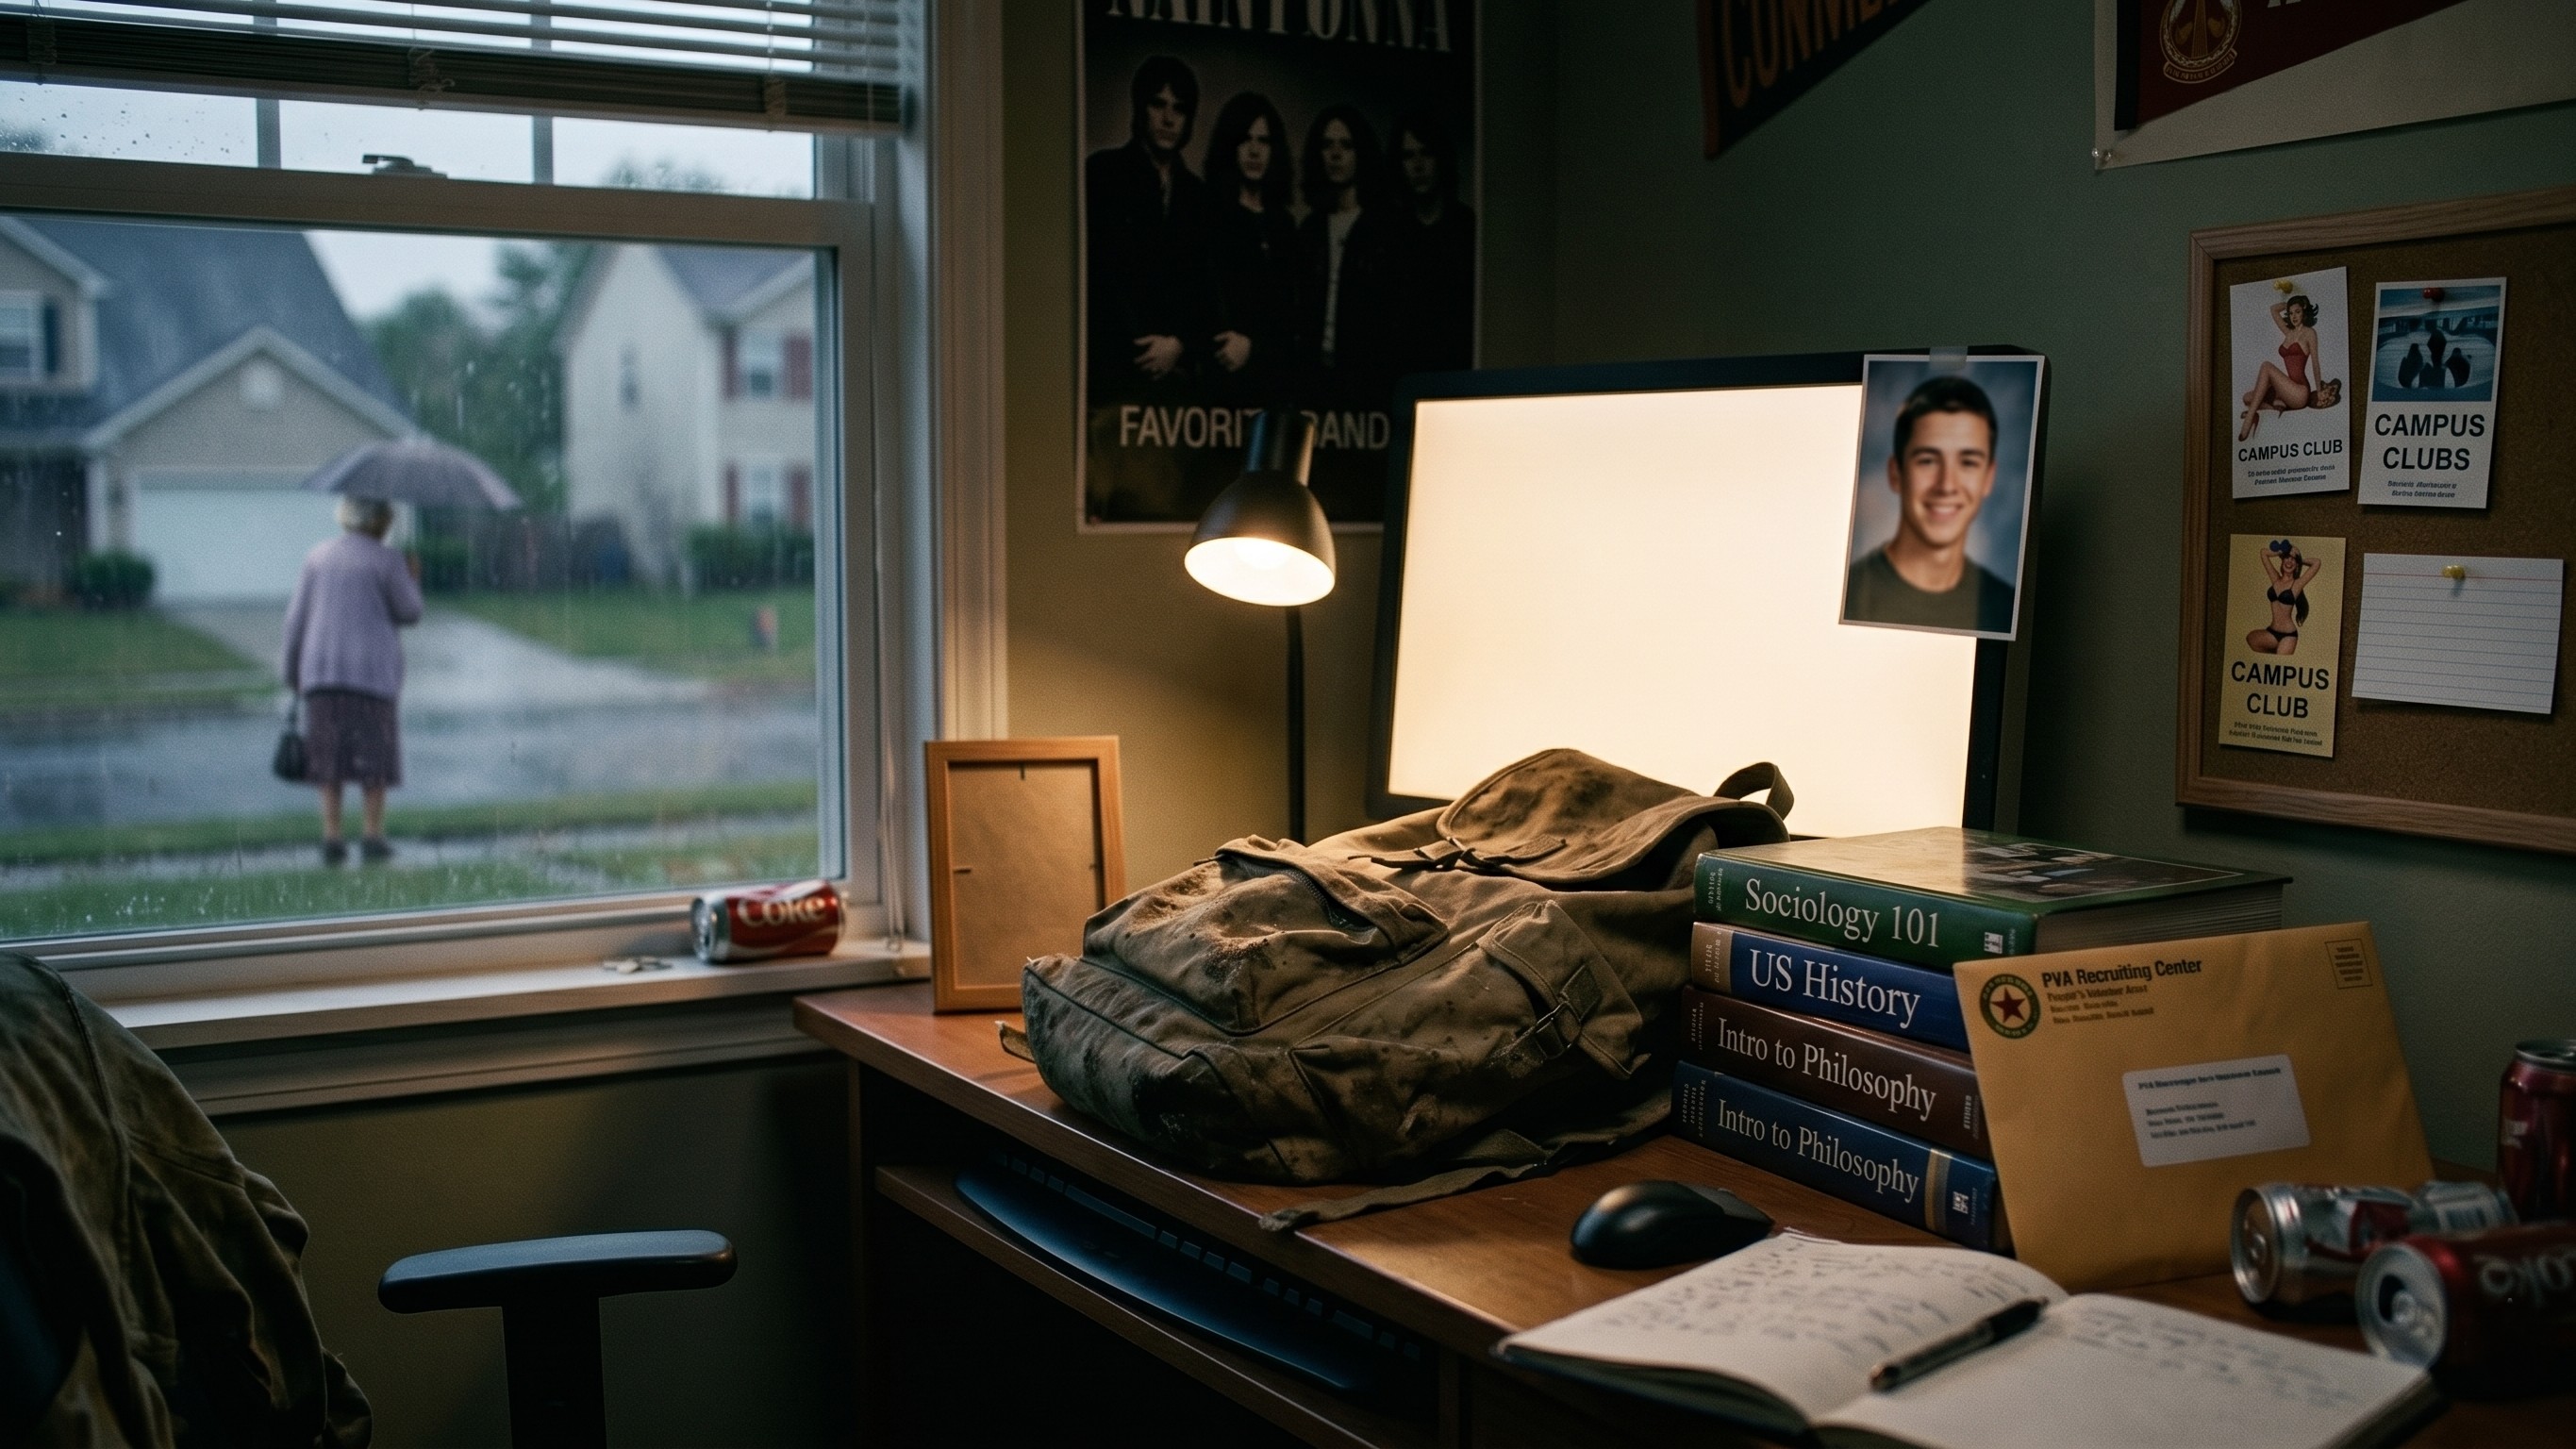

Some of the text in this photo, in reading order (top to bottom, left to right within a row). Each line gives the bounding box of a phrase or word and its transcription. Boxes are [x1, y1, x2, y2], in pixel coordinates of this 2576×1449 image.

[1119, 404, 1264, 449] FAVORI
[2375, 413, 2485, 437] CAMPUS
[2238, 439, 2343, 462] CAMPUS CLUB
[2383, 446, 2470, 471] CLUBS
[2231, 660, 2329, 691] CAMPUS
[2247, 693, 2308, 719] CLUB
[1745, 877, 1881, 943] Sociology
[1892, 905, 1938, 948] 101
[1750, 948, 1793, 991] US
[1803, 959, 1920, 1029] History
[2041, 959, 2202, 988] PVA Recruiting Center
[1718, 1017, 1769, 1061] Intro
[1775, 1039, 1796, 1070] to
[1802, 1042, 1936, 1122] Philosophy
[1718, 1098, 1766, 1141] Intro
[1771, 1121, 1791, 1150] to
[1797, 1125, 1920, 1204] Philosophy
